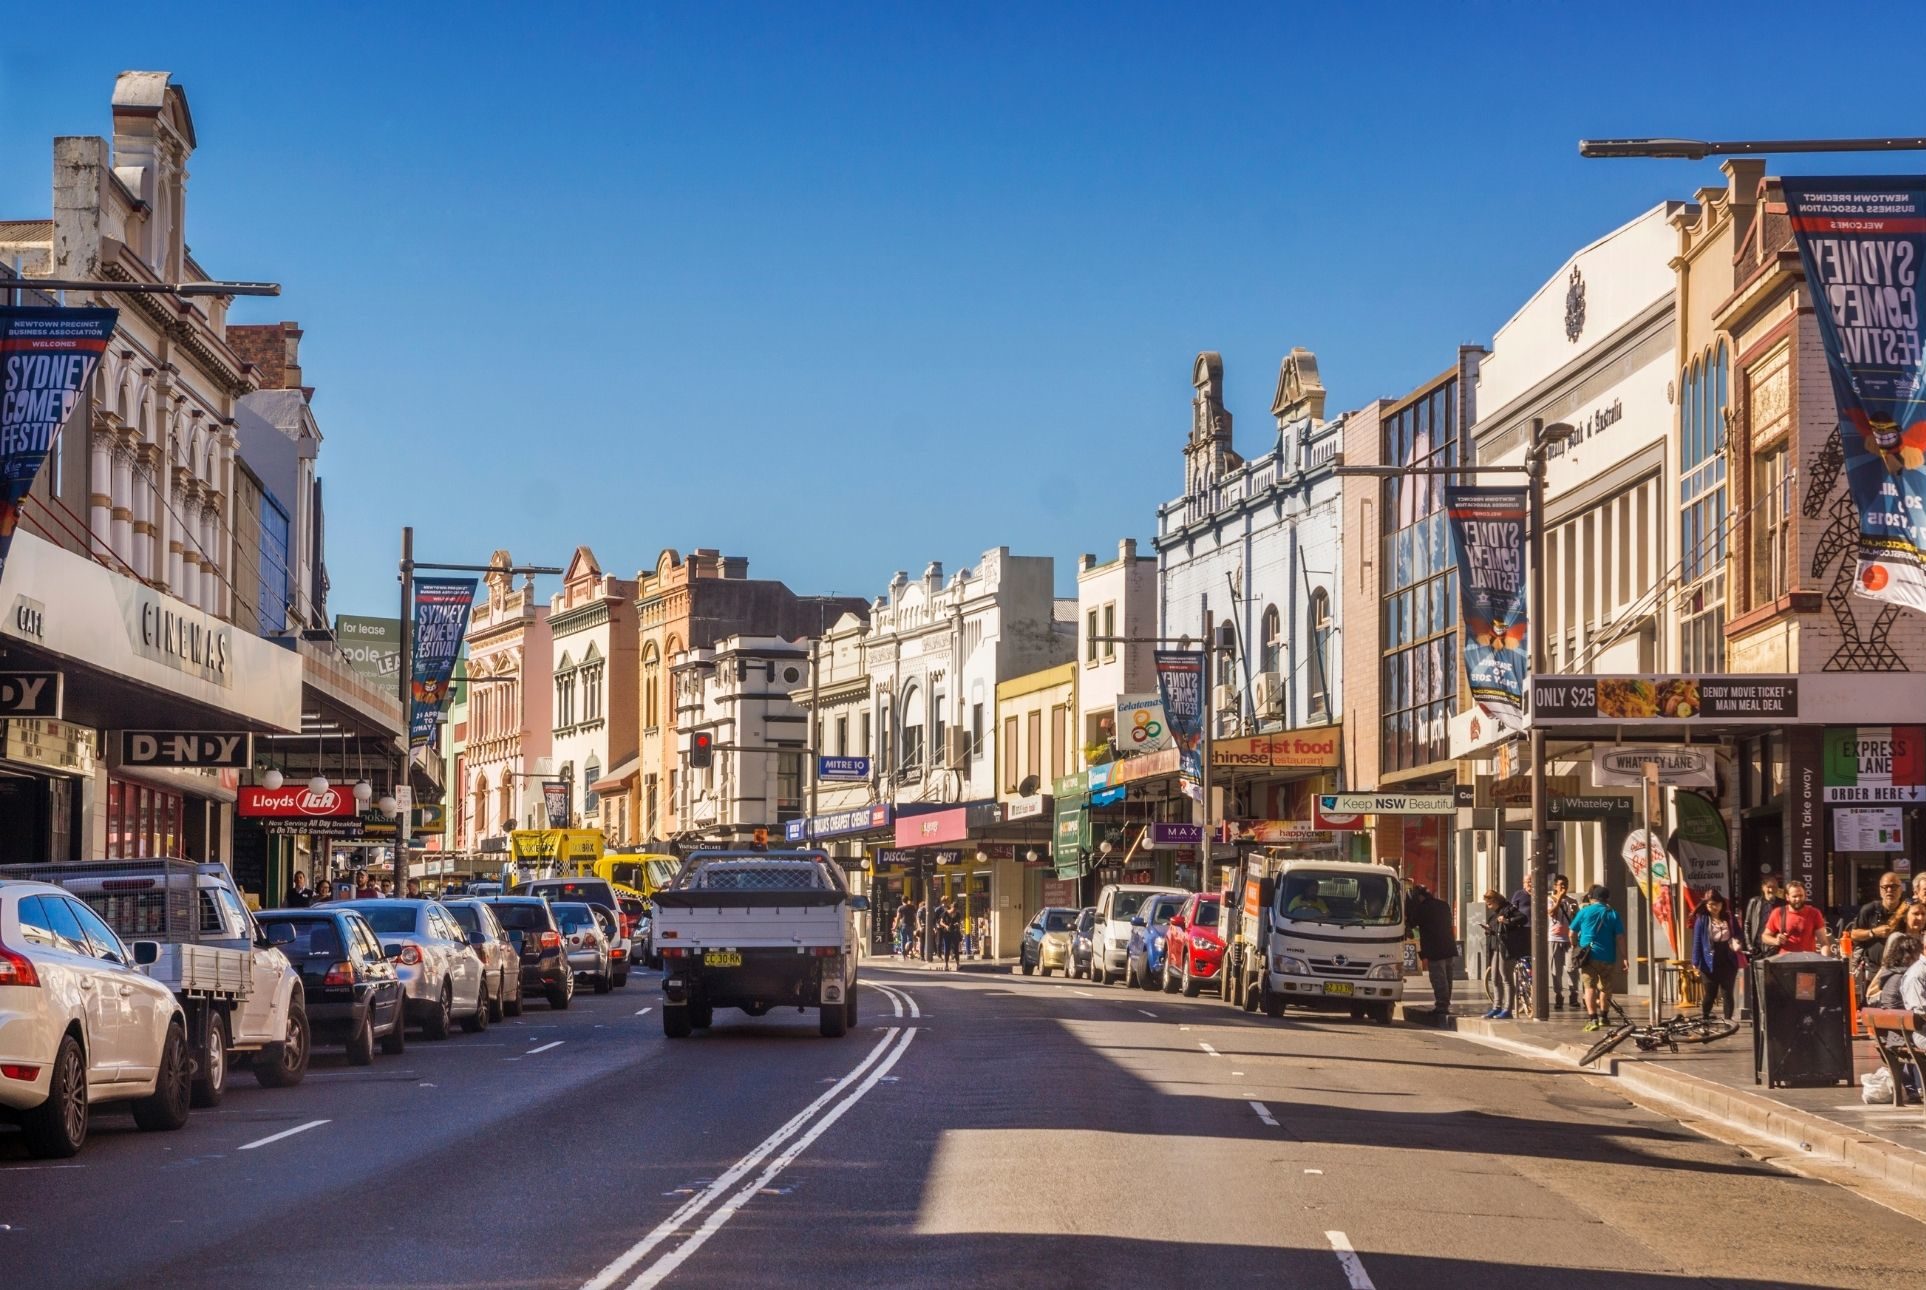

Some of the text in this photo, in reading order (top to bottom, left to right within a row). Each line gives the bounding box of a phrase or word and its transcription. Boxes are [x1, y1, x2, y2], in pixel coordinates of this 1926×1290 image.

[5, 354, 96, 391] SYDNEY
[0, 422, 65, 456] FESTIV
[419, 604, 465, 625] SYDNEY
[343, 622, 386, 635] for lease
[141, 601, 226, 674] CINEMAS
[1535, 688, 1567, 707] ONLY
[1570, 686, 1596, 708] $25
[1703, 686, 1728, 698] DENDY
[1730, 686, 1756, 698] MOVIE
[1758, 686, 1785, 698] TICKET
[1715, 699, 1784, 711] MAIN MEAL DEAL
[132, 734, 241, 762] DENDY
[1250, 739, 1334, 755] Fast food
[1843, 740, 1907, 758] EXPRESS
[825, 760, 864, 770] MITRE 10
[1272, 756, 1324, 765] restaurant
[1668, 757, 1693, 769] LANE
[1857, 757, 1893, 774] LANE
[1804, 767, 1814, 799] away
[1831, 788, 1904, 800] ORDER HERE
[252, 795, 294, 810] Lloyds
[1342, 798, 1373, 811] Keep
[1375, 798, 1406, 809] NSW
[1565, 798, 1630, 811] Whateley La
[1802, 802, 1812, 828] Take
[284, 820, 308, 828] Serving
[319, 820, 332, 828] Day
[1802, 837, 1812, 845] In
[883, 851, 906, 862] DISCO
[1802, 848, 1812, 868] Eat
[1689, 858, 1705, 869] Try
[1688, 871, 1724, 880] delicious
[1802, 874, 1812, 902] ood
[1403, 951, 1416, 960] 0%
